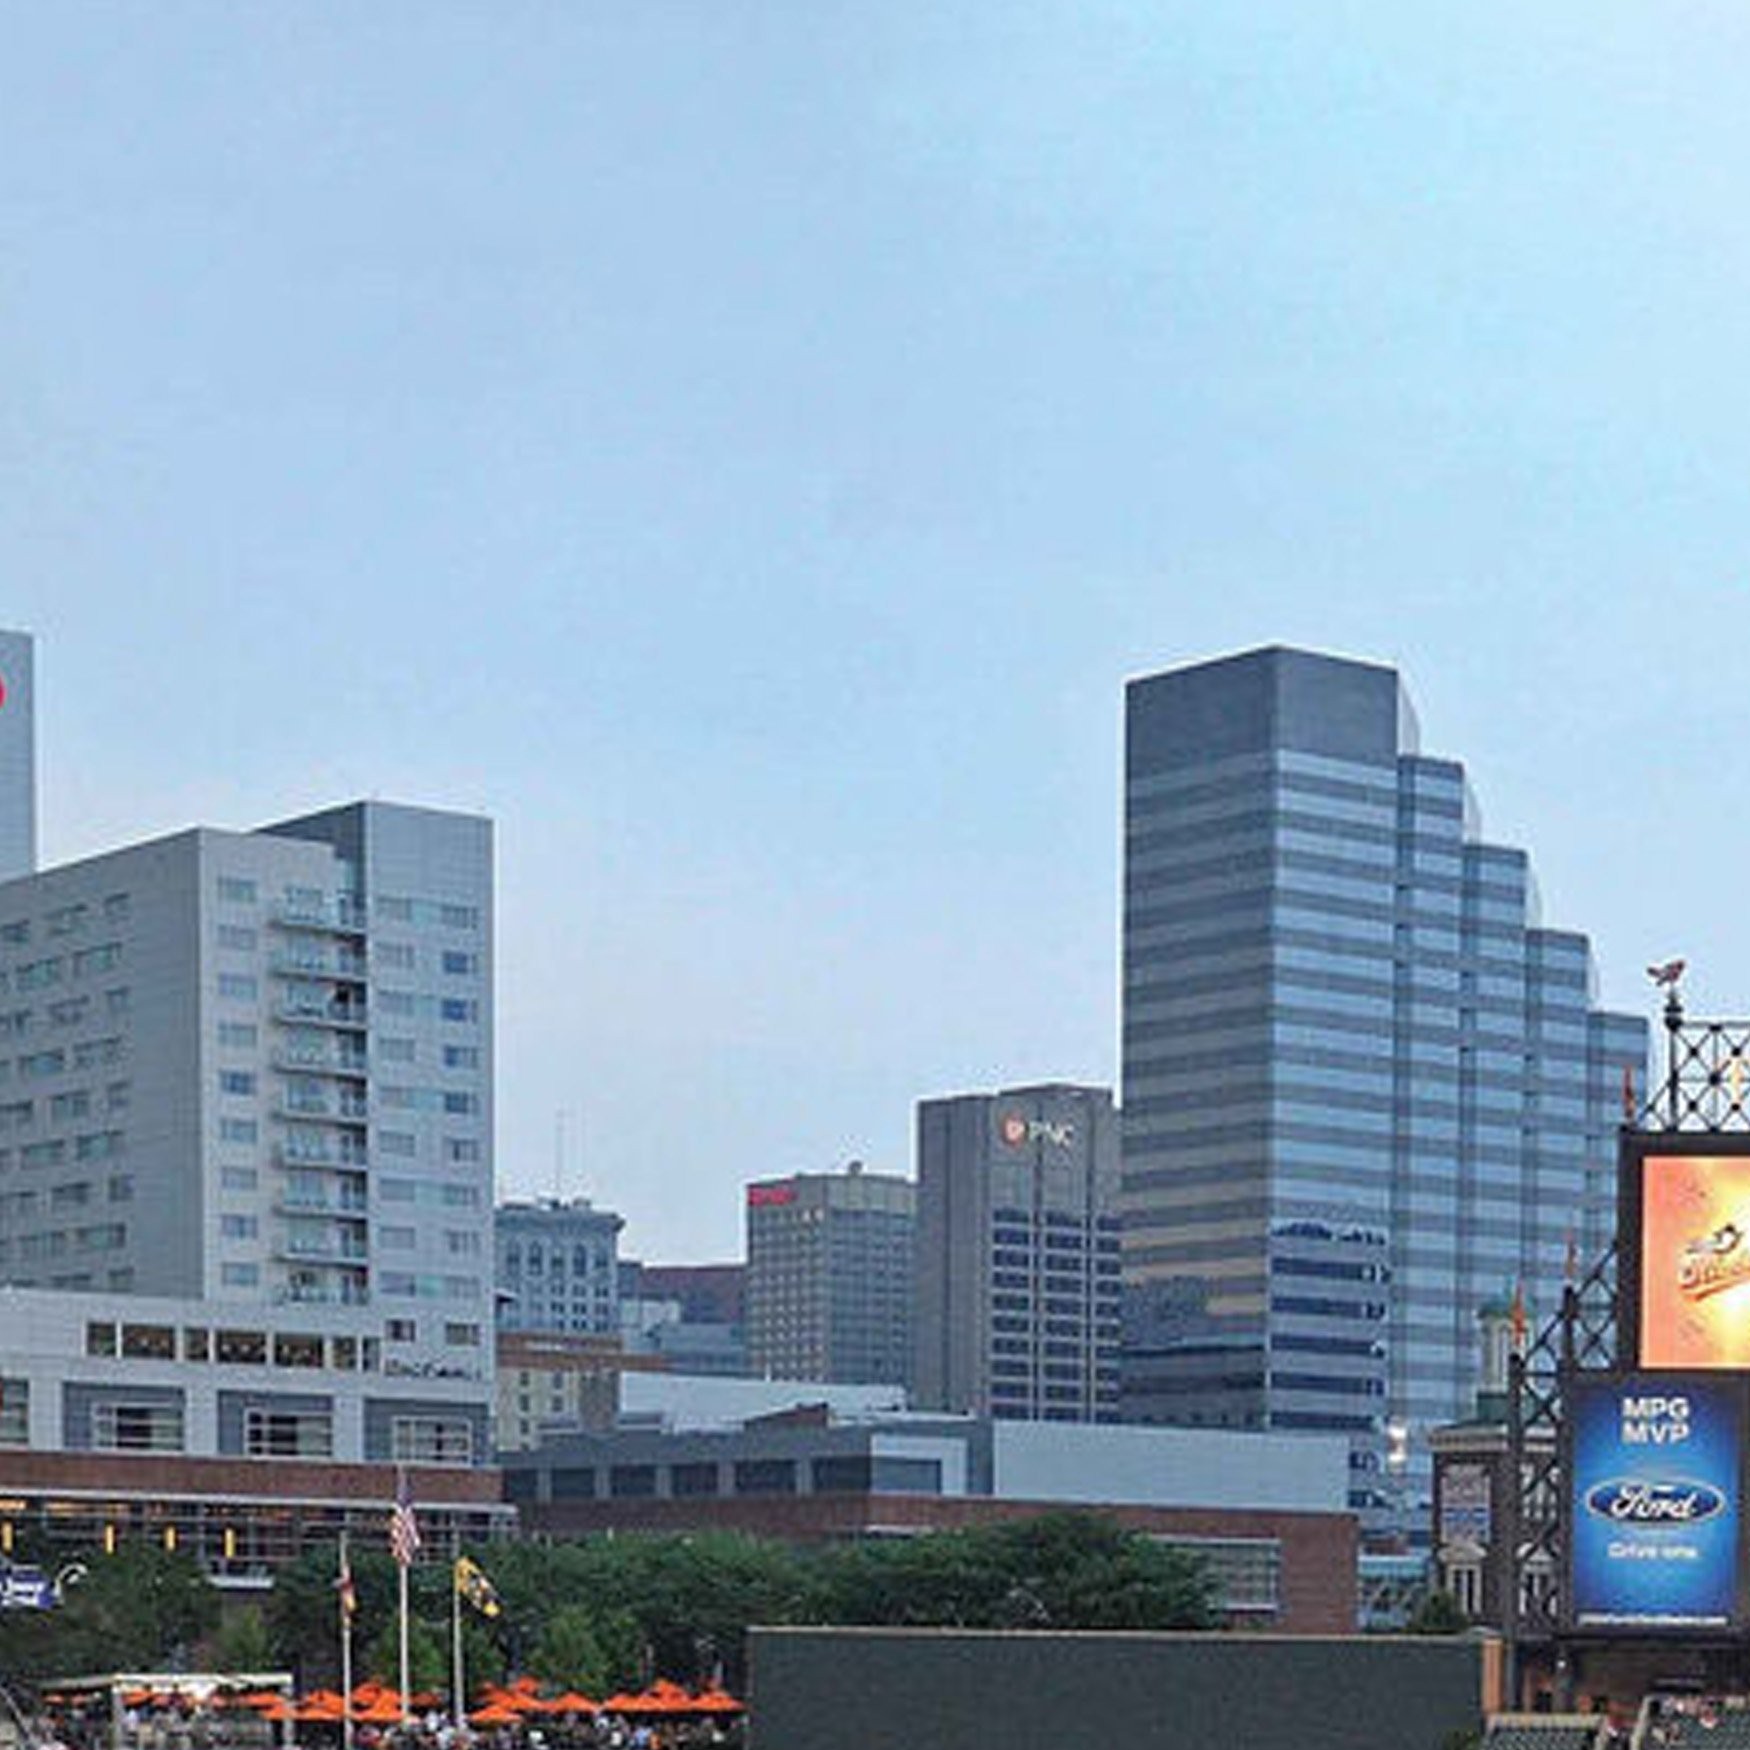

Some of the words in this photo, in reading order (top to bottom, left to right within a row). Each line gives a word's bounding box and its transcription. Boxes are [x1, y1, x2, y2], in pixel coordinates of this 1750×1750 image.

[1623, 1396, 1691, 1421] MPG
[1622, 1420, 1690, 1444] MVP
[1610, 1484, 1698, 1520] Ford
